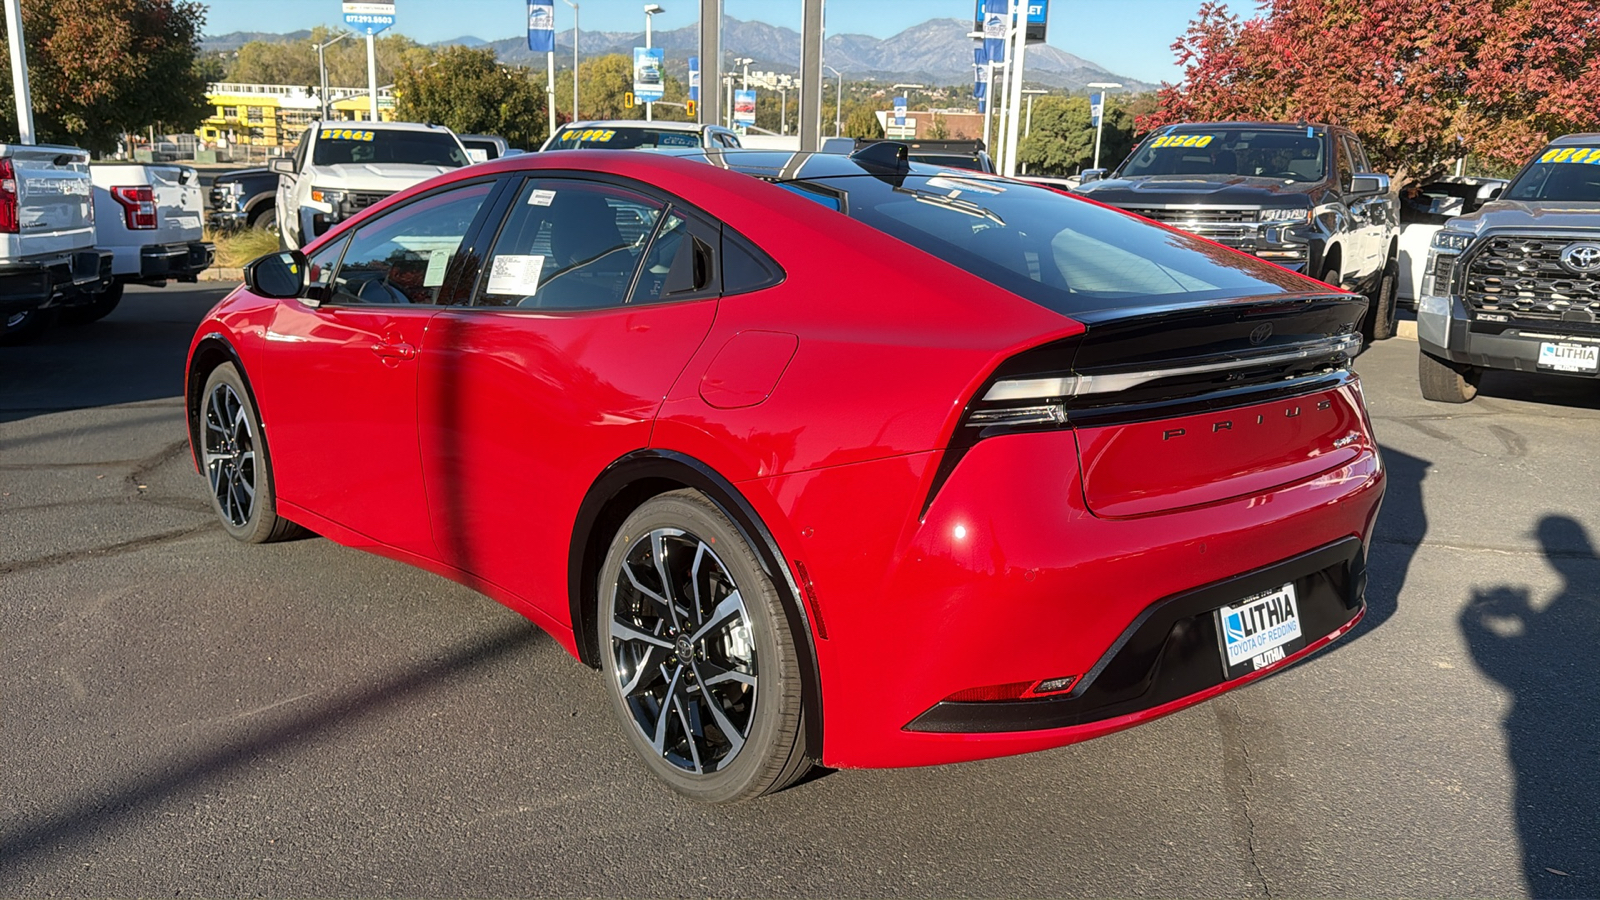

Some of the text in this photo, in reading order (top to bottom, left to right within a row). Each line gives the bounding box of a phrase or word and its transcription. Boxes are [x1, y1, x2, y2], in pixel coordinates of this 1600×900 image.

[320, 129, 374, 141] 37465
[561, 129, 616, 142] 40995
[1150, 135, 1212, 148] 31560
[1555, 347, 1595, 361] LITHIA
[1162, 399, 1332, 441] PRIUS
[1240, 593, 1295, 638] LITHIA
[1228, 620, 1297, 657] TOYOTA OF REDDING
[1261, 646, 1286, 665] LITHIA
